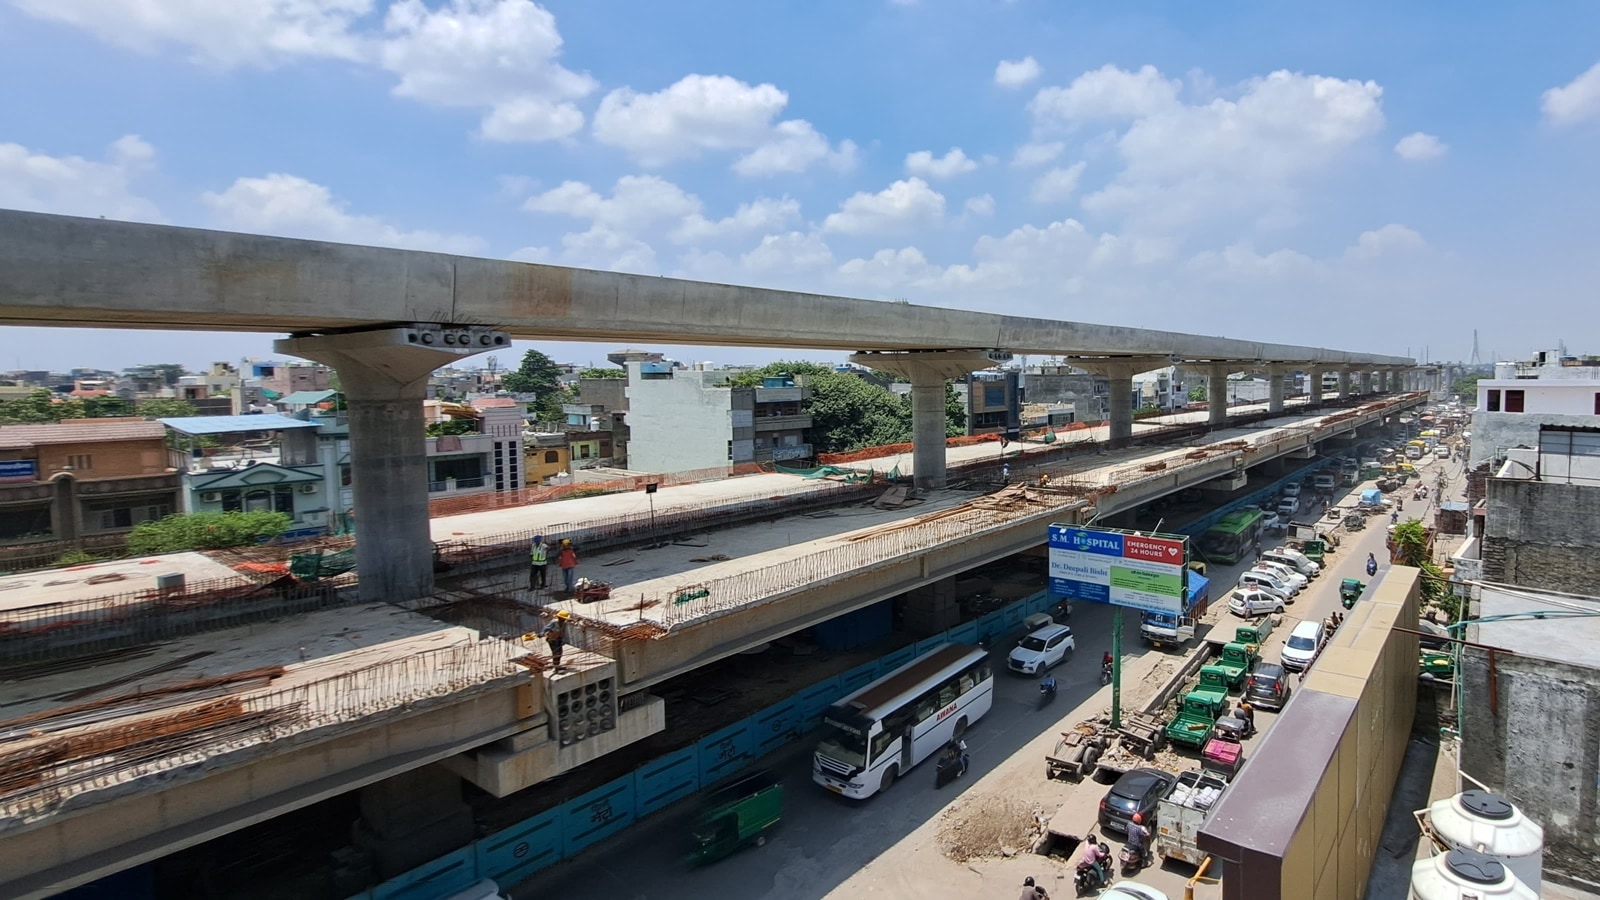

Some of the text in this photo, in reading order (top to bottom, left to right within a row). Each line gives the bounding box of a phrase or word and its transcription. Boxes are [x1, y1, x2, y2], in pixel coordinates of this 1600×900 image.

[1127, 540, 1167, 551] EMERGENCY
[1140, 548, 1163, 557] HOURS
[1051, 561, 1062, 569] Dr.
[1063, 563, 1089, 575] Deepali
